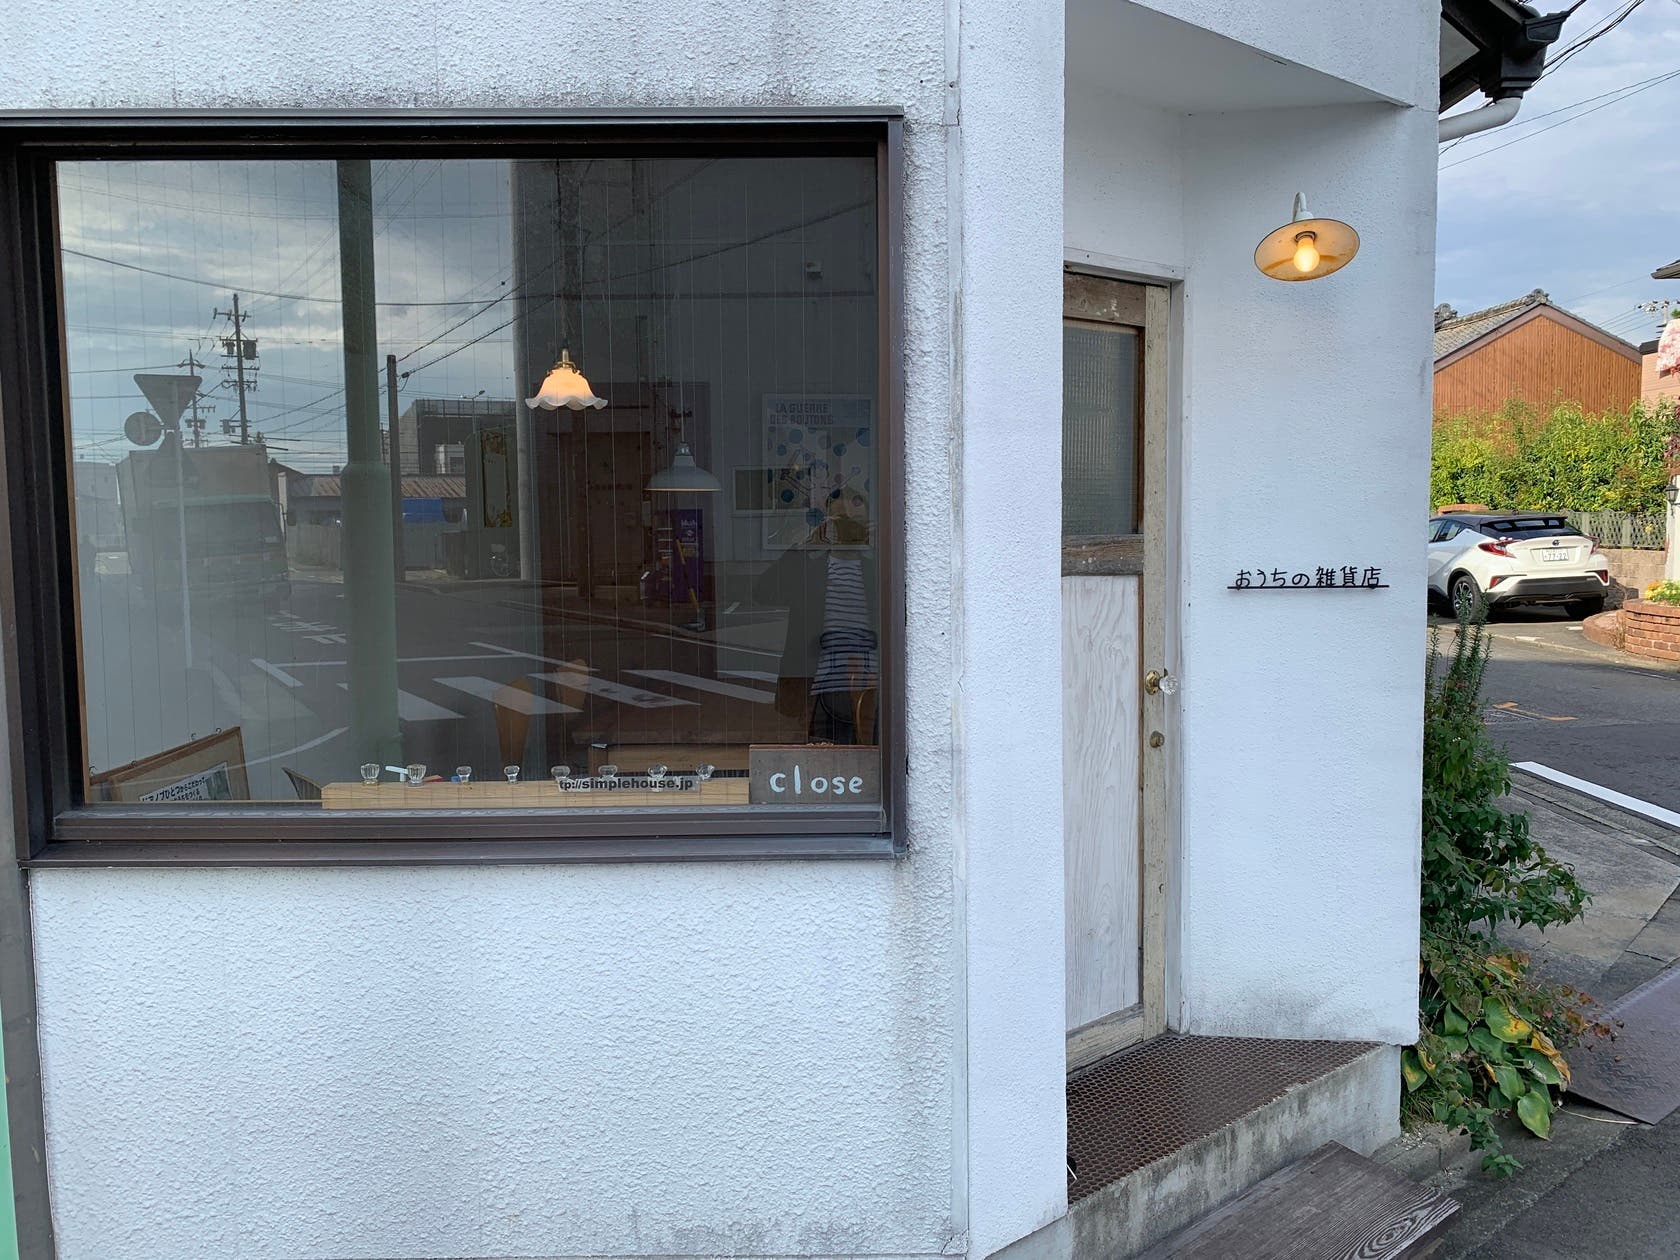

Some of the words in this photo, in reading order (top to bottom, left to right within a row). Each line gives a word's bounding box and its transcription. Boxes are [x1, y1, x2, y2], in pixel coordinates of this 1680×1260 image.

[775, 403, 787, 414] LA
[789, 403, 829, 414] GUERRE
[769, 414, 787, 425] DES
[790, 414, 834, 425] BOUTONS
[1235, 565, 1382, 590] おうちの雑貨店
[559, 777, 693, 791] tp://simplehouse.jp
[769, 764, 864, 795] close
